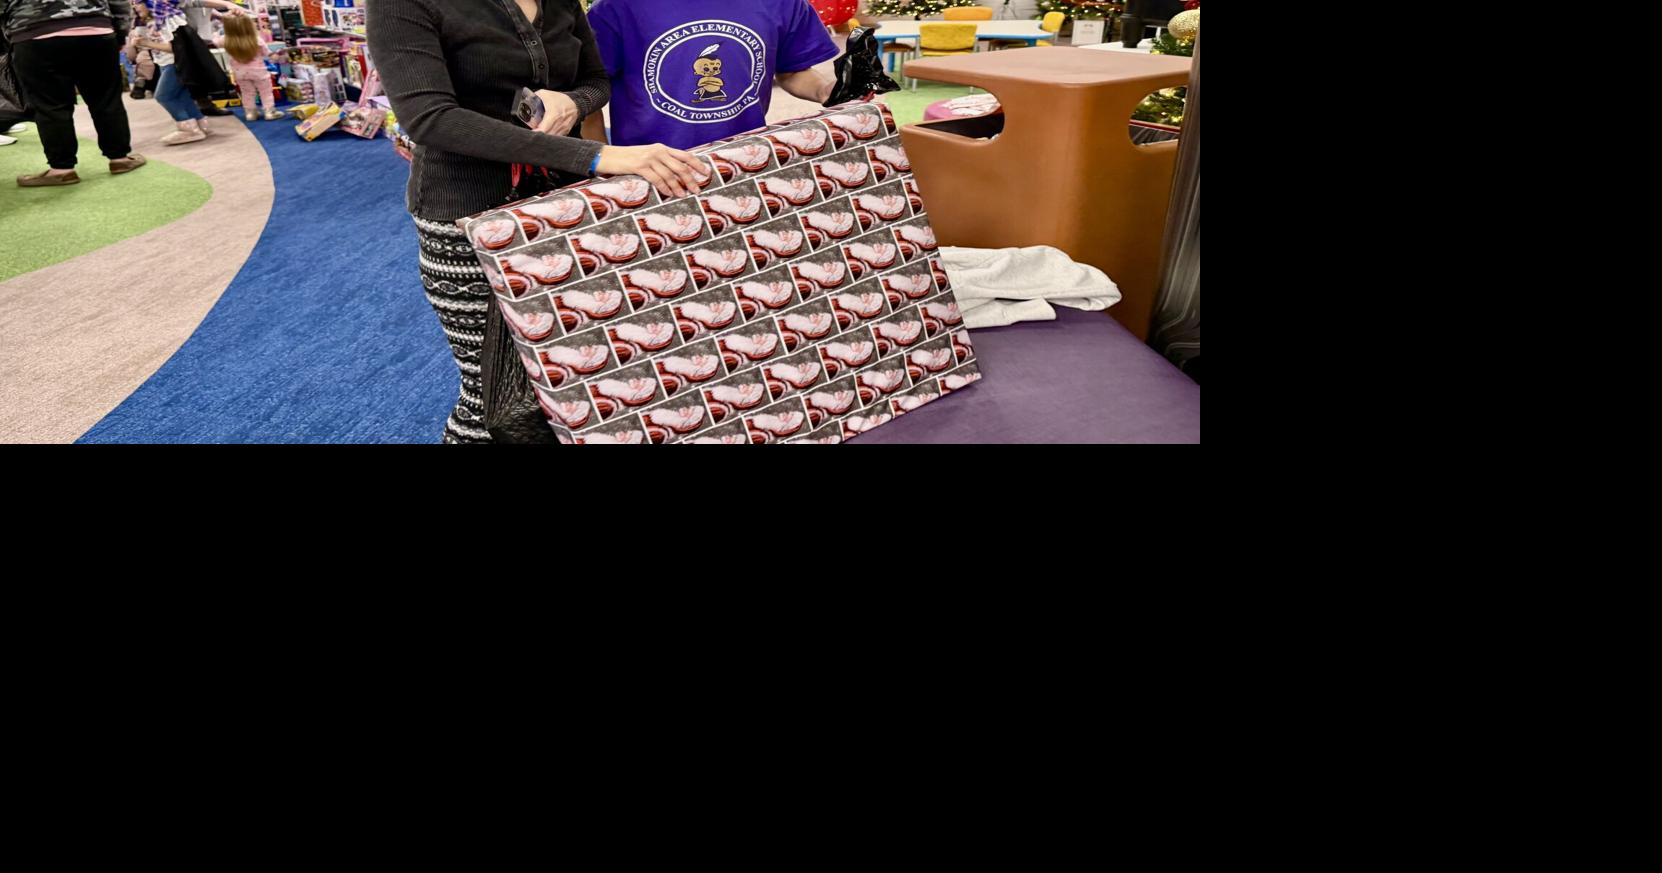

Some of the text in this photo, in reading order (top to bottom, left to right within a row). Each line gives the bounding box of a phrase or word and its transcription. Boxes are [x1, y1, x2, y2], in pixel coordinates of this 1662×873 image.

[647, 47, 662, 94] SHAMOKIN
[660, 29, 690, 48] AREA
[691, 24, 761, 50] ELEMENTARY
[661, 101, 687, 117] COAL
[742, 95, 755, 105] PA
